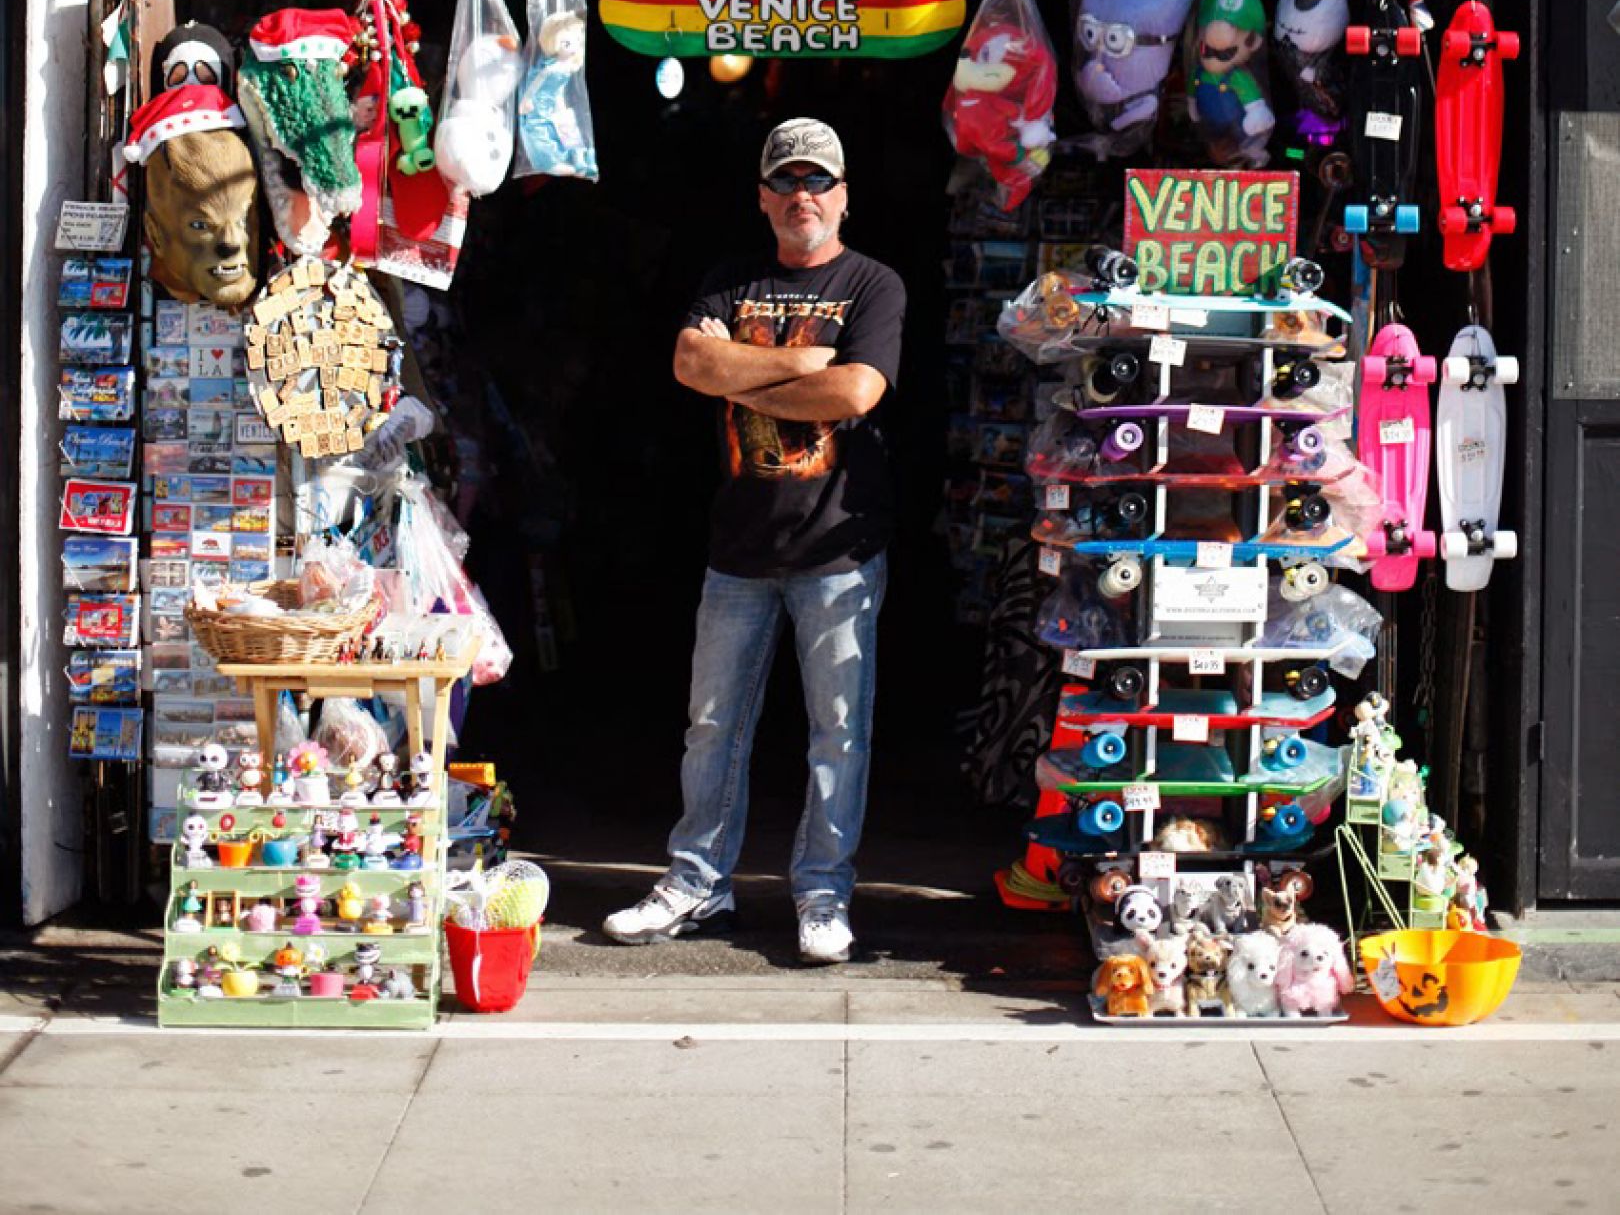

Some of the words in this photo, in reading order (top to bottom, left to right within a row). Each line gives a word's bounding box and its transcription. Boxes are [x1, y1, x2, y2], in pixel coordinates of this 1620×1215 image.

[705, 22, 860, 52] BEACH
[1128, 175, 1290, 233] VENICE
[1135, 238, 1289, 298] BEACH
